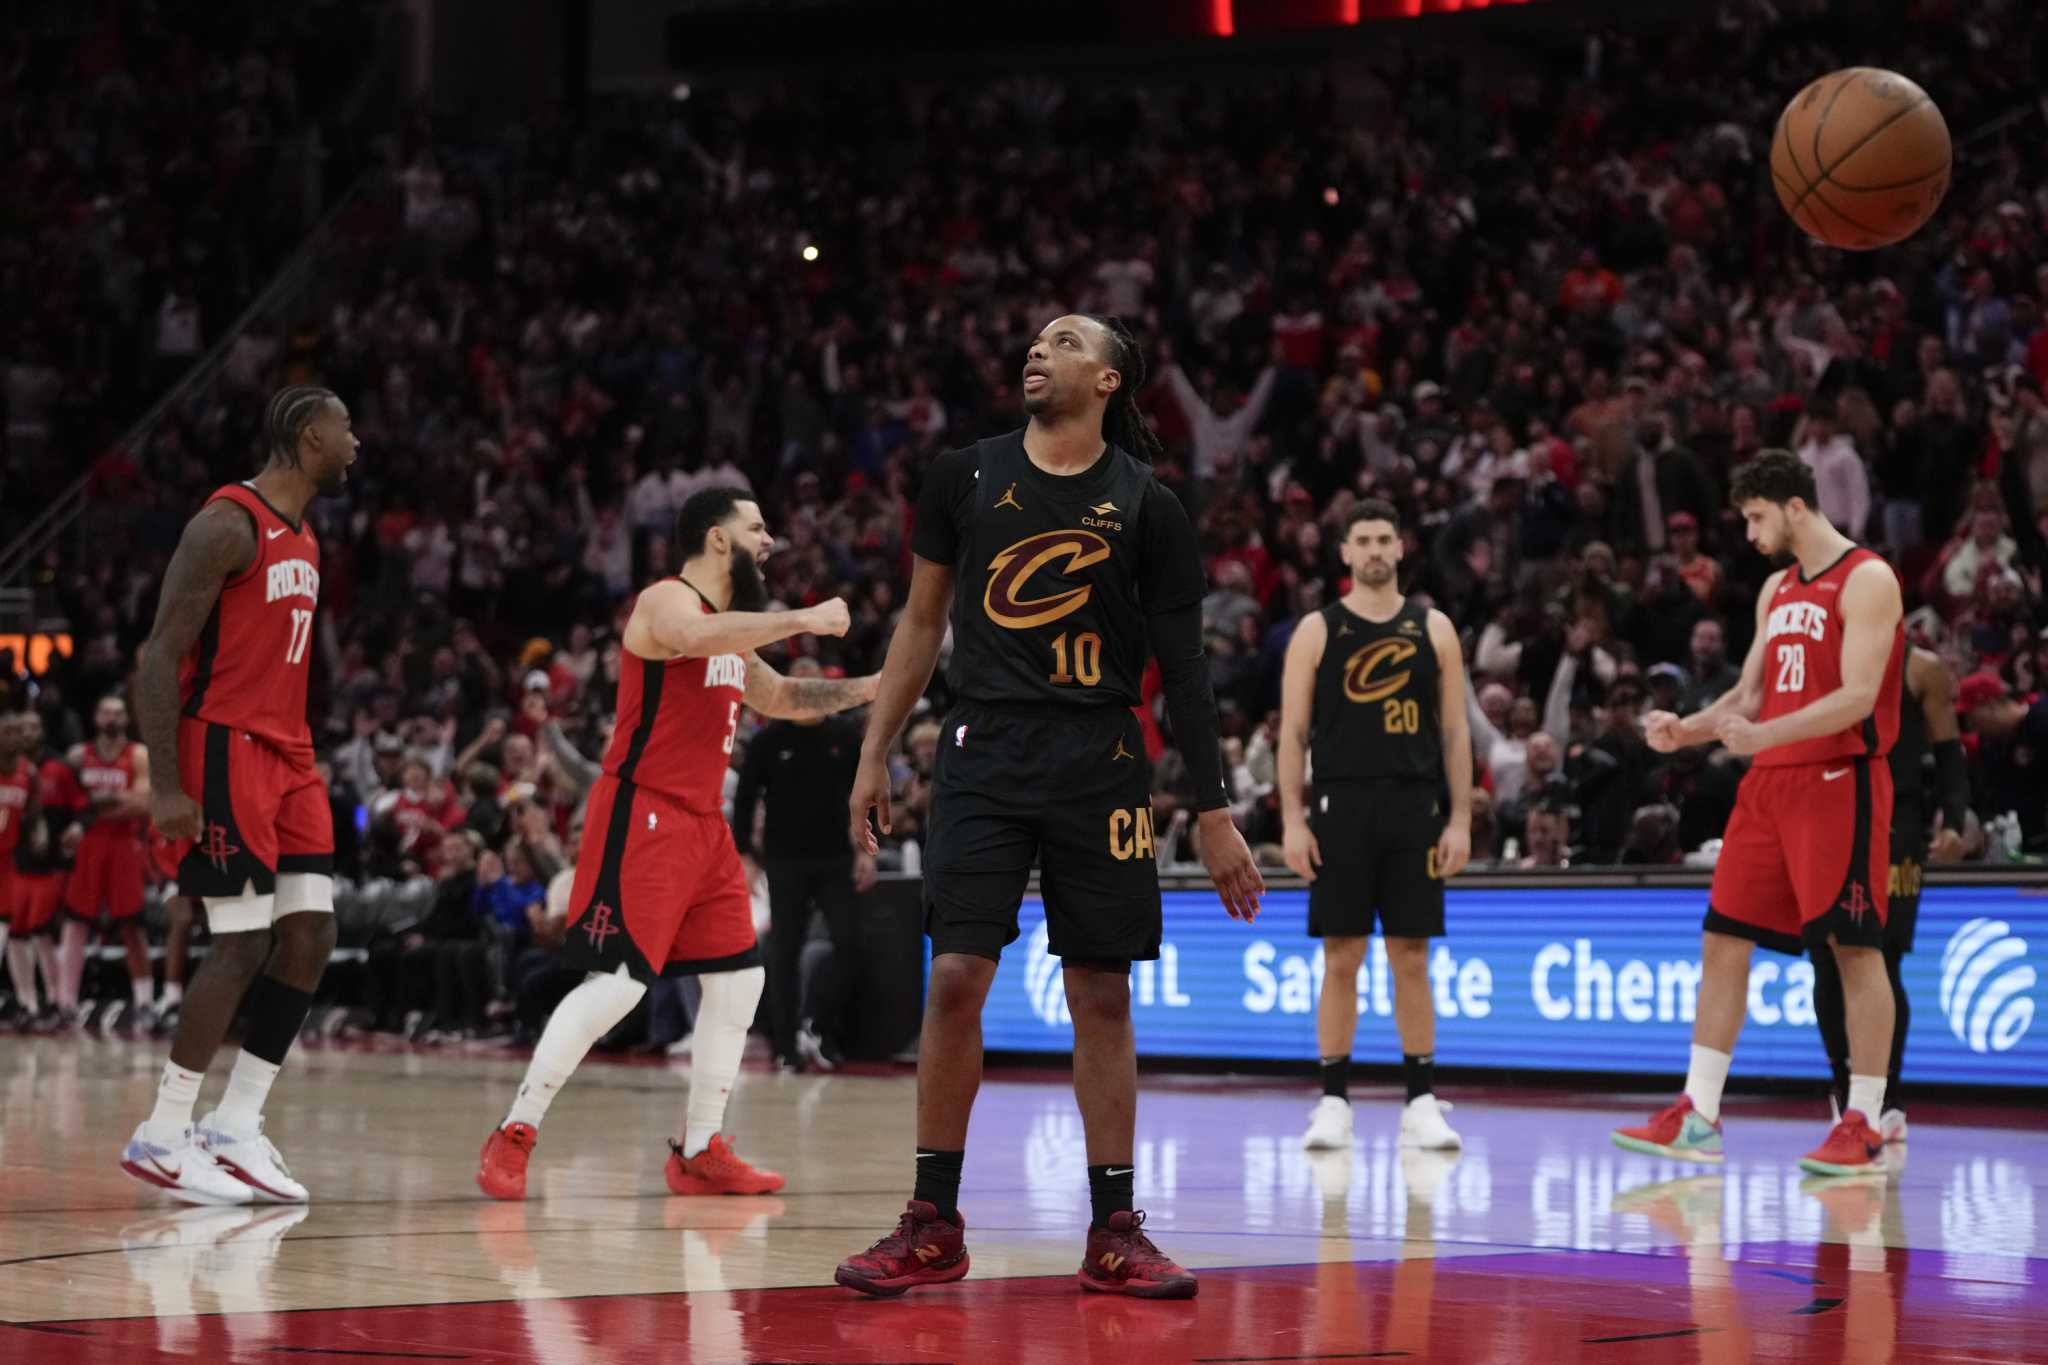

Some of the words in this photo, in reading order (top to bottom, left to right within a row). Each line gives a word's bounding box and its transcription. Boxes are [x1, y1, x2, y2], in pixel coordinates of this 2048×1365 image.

[286, 607, 313, 664] 17
[1049, 631, 1102, 686] 10
[1776, 643, 1805, 692] 28
[723, 701, 738, 754] 5
[1384, 699, 1419, 734] 20
[1109, 808, 1155, 860] CA
